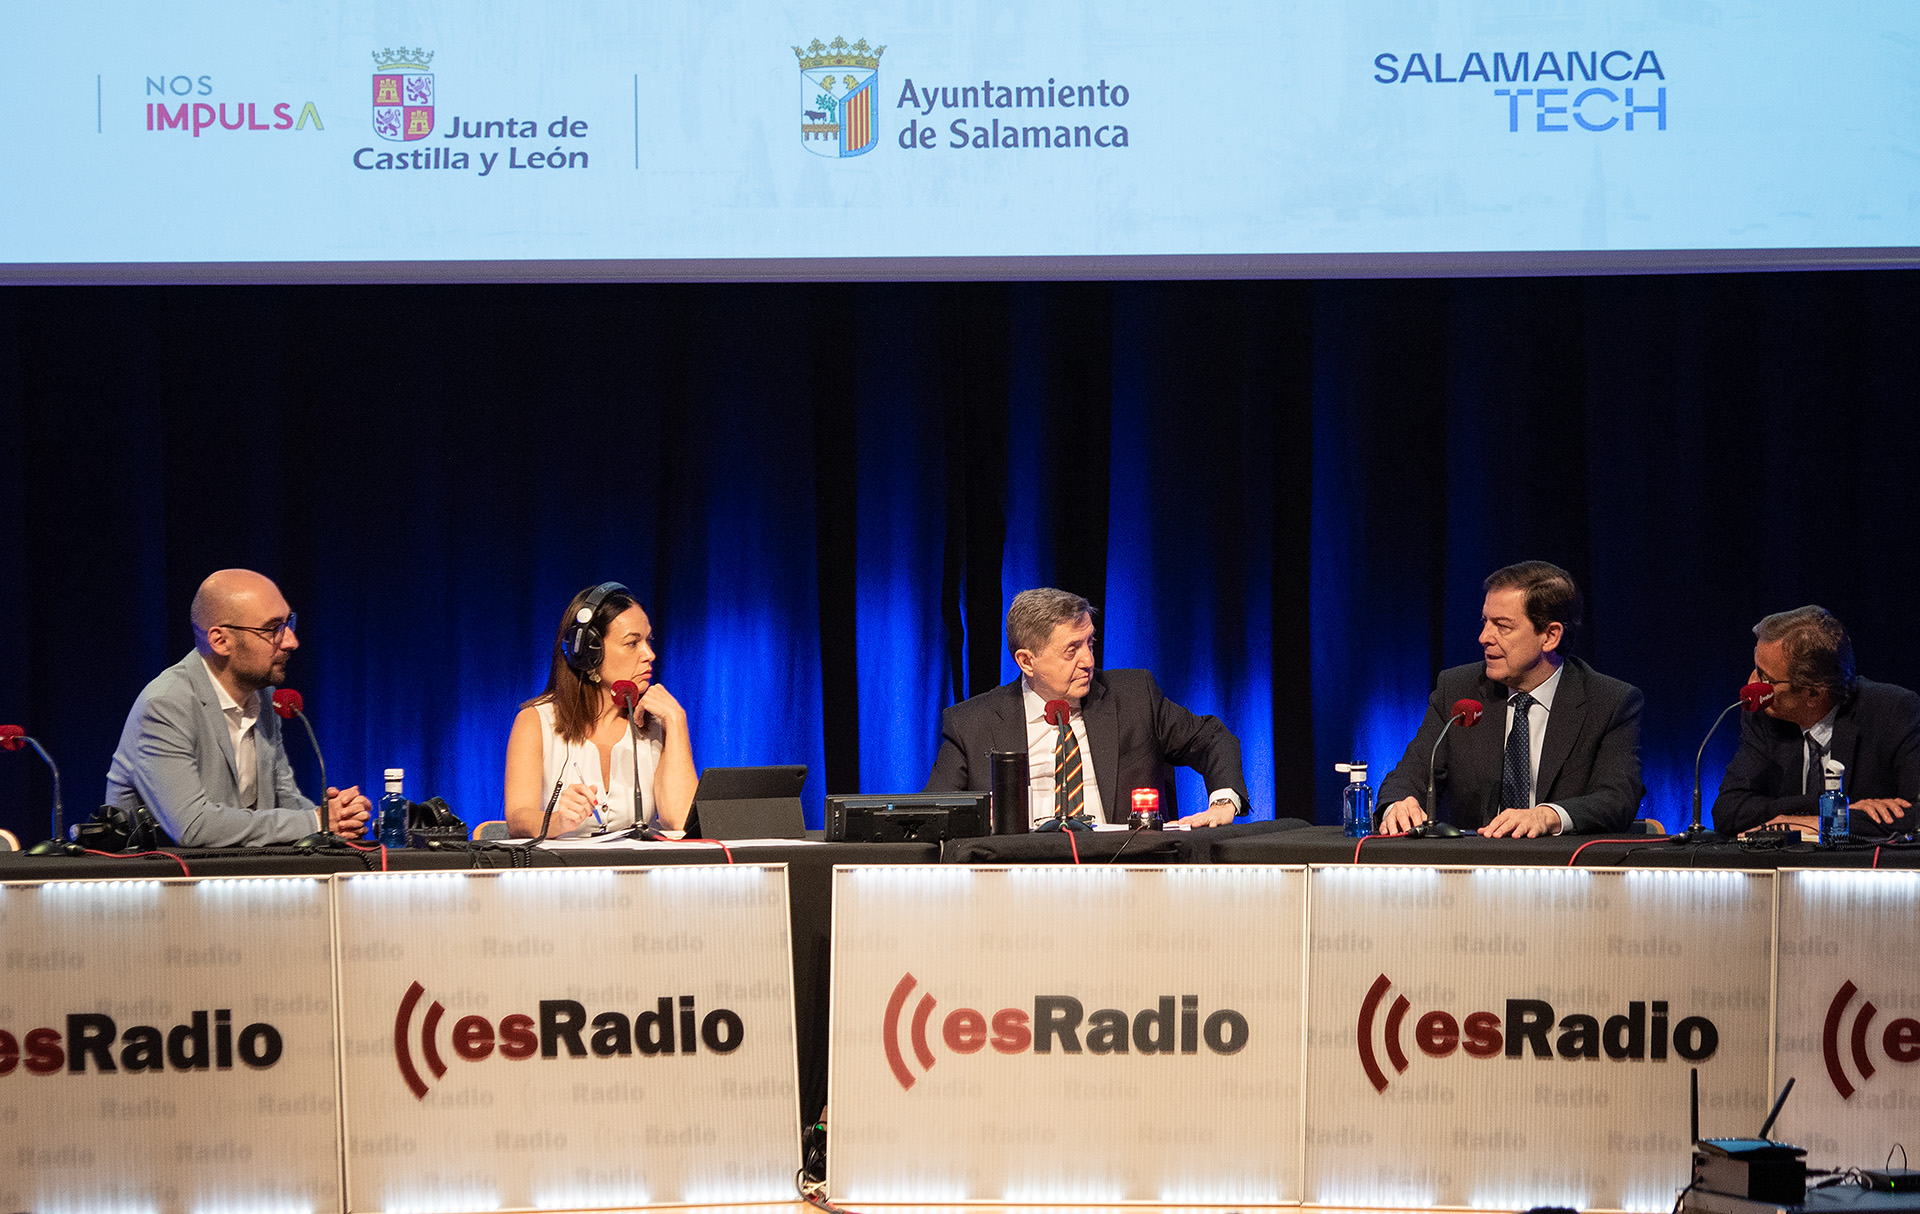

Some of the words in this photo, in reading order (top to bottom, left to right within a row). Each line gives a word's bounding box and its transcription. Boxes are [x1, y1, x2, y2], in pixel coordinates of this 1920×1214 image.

[1374, 50, 1665, 84] SALAMANCA
[147, 76, 212, 96] NOS
[897, 78, 1129, 116] Ayuntamiento
[147, 102, 324, 137] IMPULSA
[444, 117, 537, 138] Junta
[548, 116, 588, 138] de
[1494, 87, 1666, 132] TECH
[898, 119, 936, 149] de
[950, 119, 1128, 149] Salamanca
[353, 147, 469, 170] Castilla
[479, 152, 498, 176] y
[509, 146, 588, 169] León
[452, 995, 744, 1062] esRadio
[943, 995, 1249, 1055] esRadio
[1416, 999, 1718, 1062] esRadio
